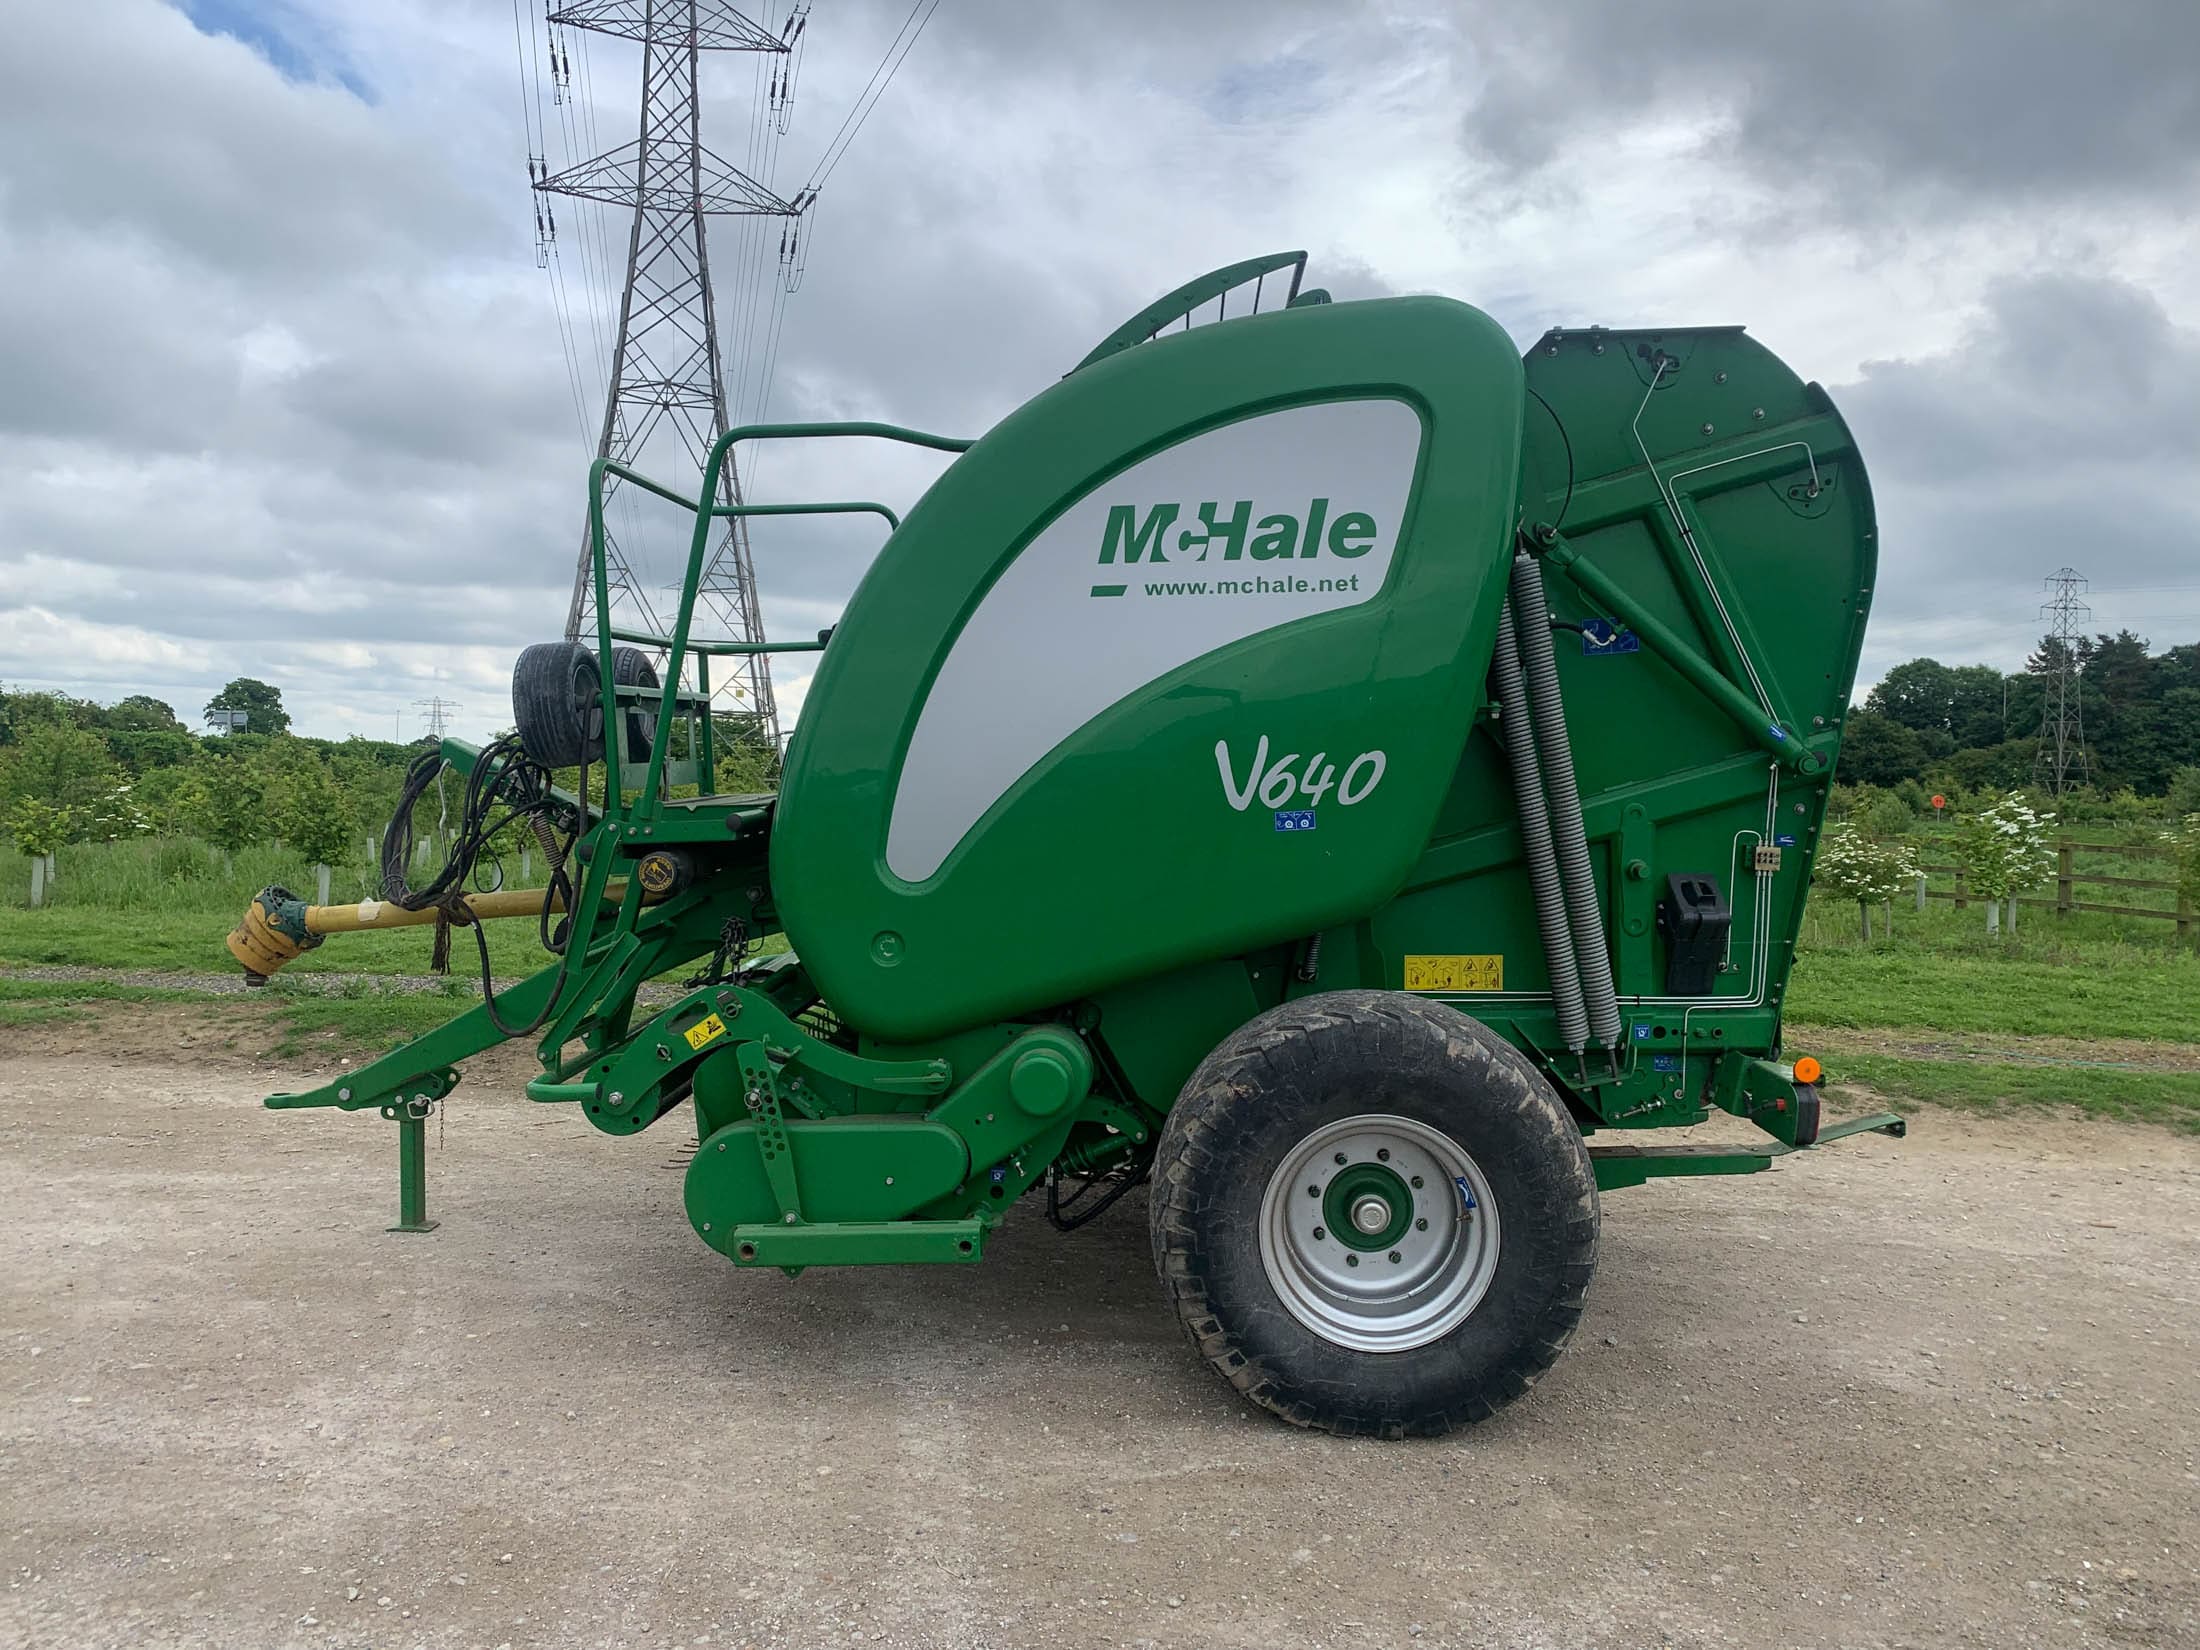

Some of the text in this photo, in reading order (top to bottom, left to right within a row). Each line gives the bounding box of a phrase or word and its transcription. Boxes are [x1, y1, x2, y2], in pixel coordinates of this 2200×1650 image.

[1098, 498, 1377, 564] McHale
[1144, 574, 1359, 596] www.mchale.net
[1215, 735, 1387, 811] V640
